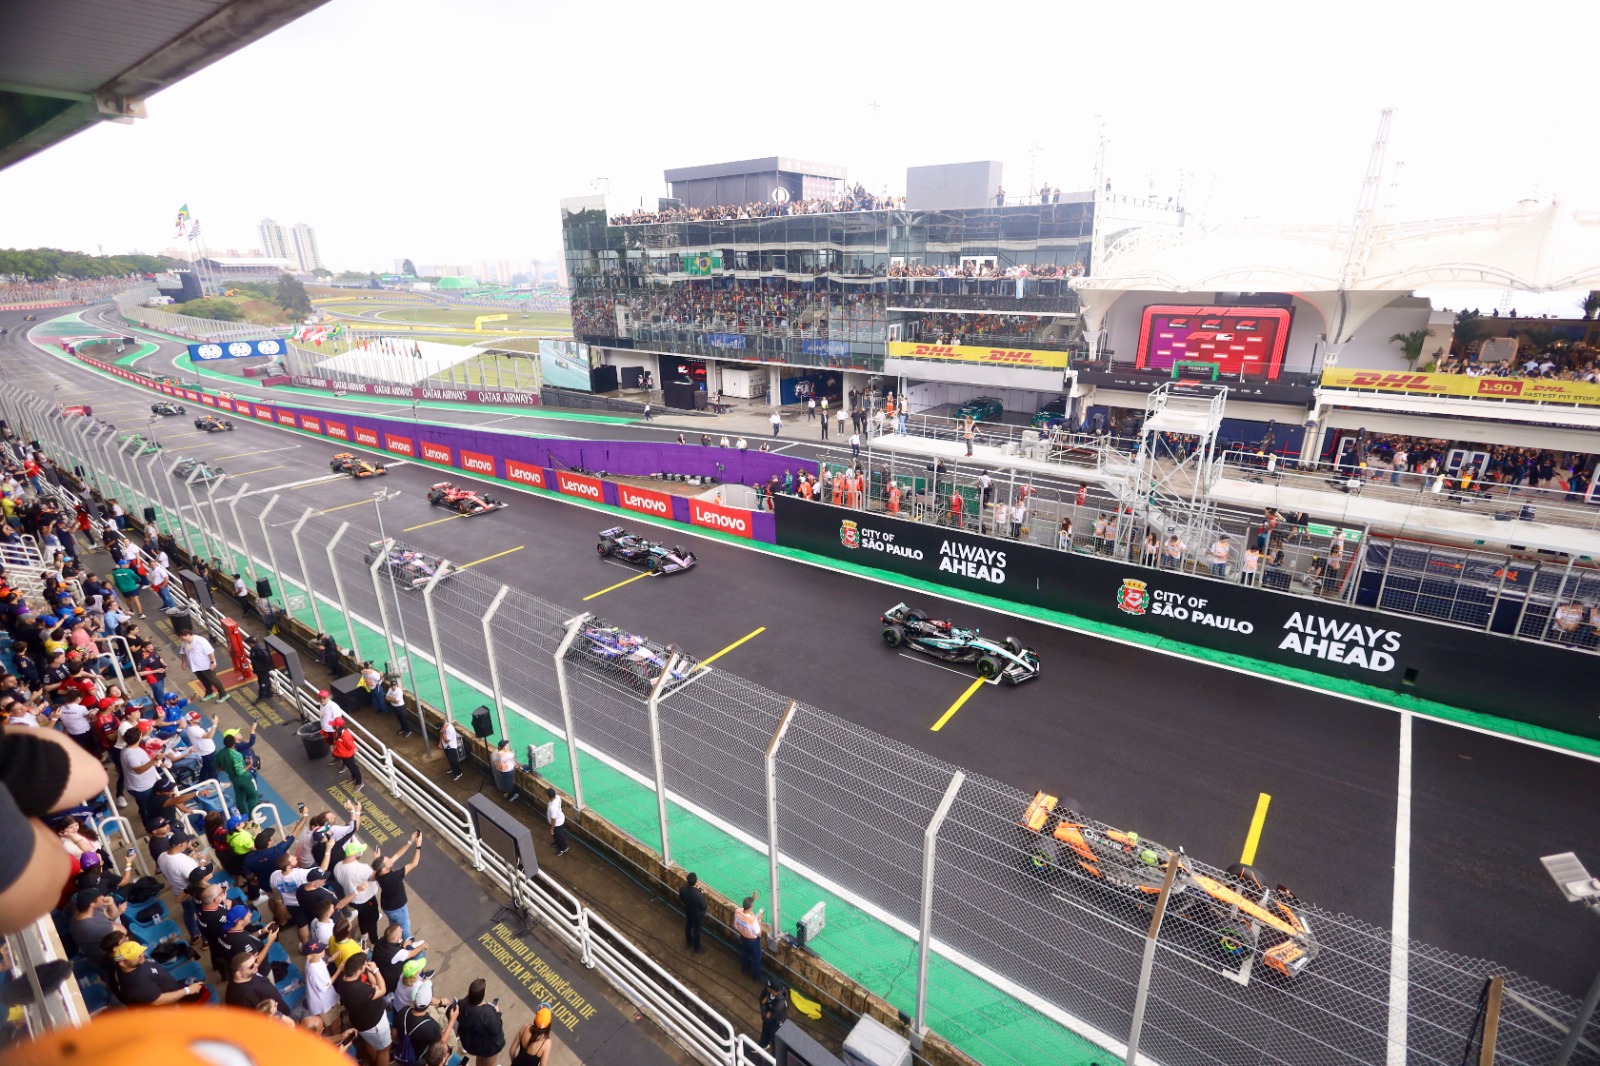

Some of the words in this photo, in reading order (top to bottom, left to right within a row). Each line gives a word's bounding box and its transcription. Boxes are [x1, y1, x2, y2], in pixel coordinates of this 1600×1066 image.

[914, 345, 956, 357] DHL
[989, 350, 1034, 363] DHL
[1350, 371, 1431, 390] DHL
[374, 385, 391, 395] QATAR
[423, 388, 441, 399] QATAR
[442, 390, 467, 400] AIRWAYS
[479, 391, 501, 403] QATAR
[503, 393, 533, 404] AIRWAYS
[302, 418, 319, 430] Lenovo
[328, 425, 346, 437] Lenovo
[356, 431, 376, 444] Lenovo
[388, 438, 410, 452] Lenovo
[424, 446, 449, 461] Lenovo
[464, 456, 492, 471] Lenovo
[510, 467, 541, 483] Lenovo
[561, 477, 599, 497] Lenovo
[623, 490, 667, 513] Lenovo
[695, 506, 746, 531] Lenovo
[861, 528, 880, 540] CITY
[882, 532, 895, 542] OF
[861, 538, 885, 552] SÃO
[886, 544, 924, 561] PAULO
[939, 540, 1007, 568] ALWAYS
[938, 556, 1006, 584] AHEAD
[1153, 589, 1184, 605] CITY
[1189, 597, 1208, 609] OF
[1151, 601, 1189, 620] SÃO
[1191, 611, 1254, 635] PAULO
[1283, 611, 1402, 652] ALWAYS
[1278, 632, 1396, 672] AHEAD
[478, 932, 514, 966] PESSOAS
[507, 960, 525, 977] EM
[517, 970, 537, 986] PÉ
[551, 1001, 580, 1032] LOCAL
[522, 952, 536, 962] A
[529, 957, 585, 1010] PERMANÊNCIA
[578, 1003, 597, 1020] DE
